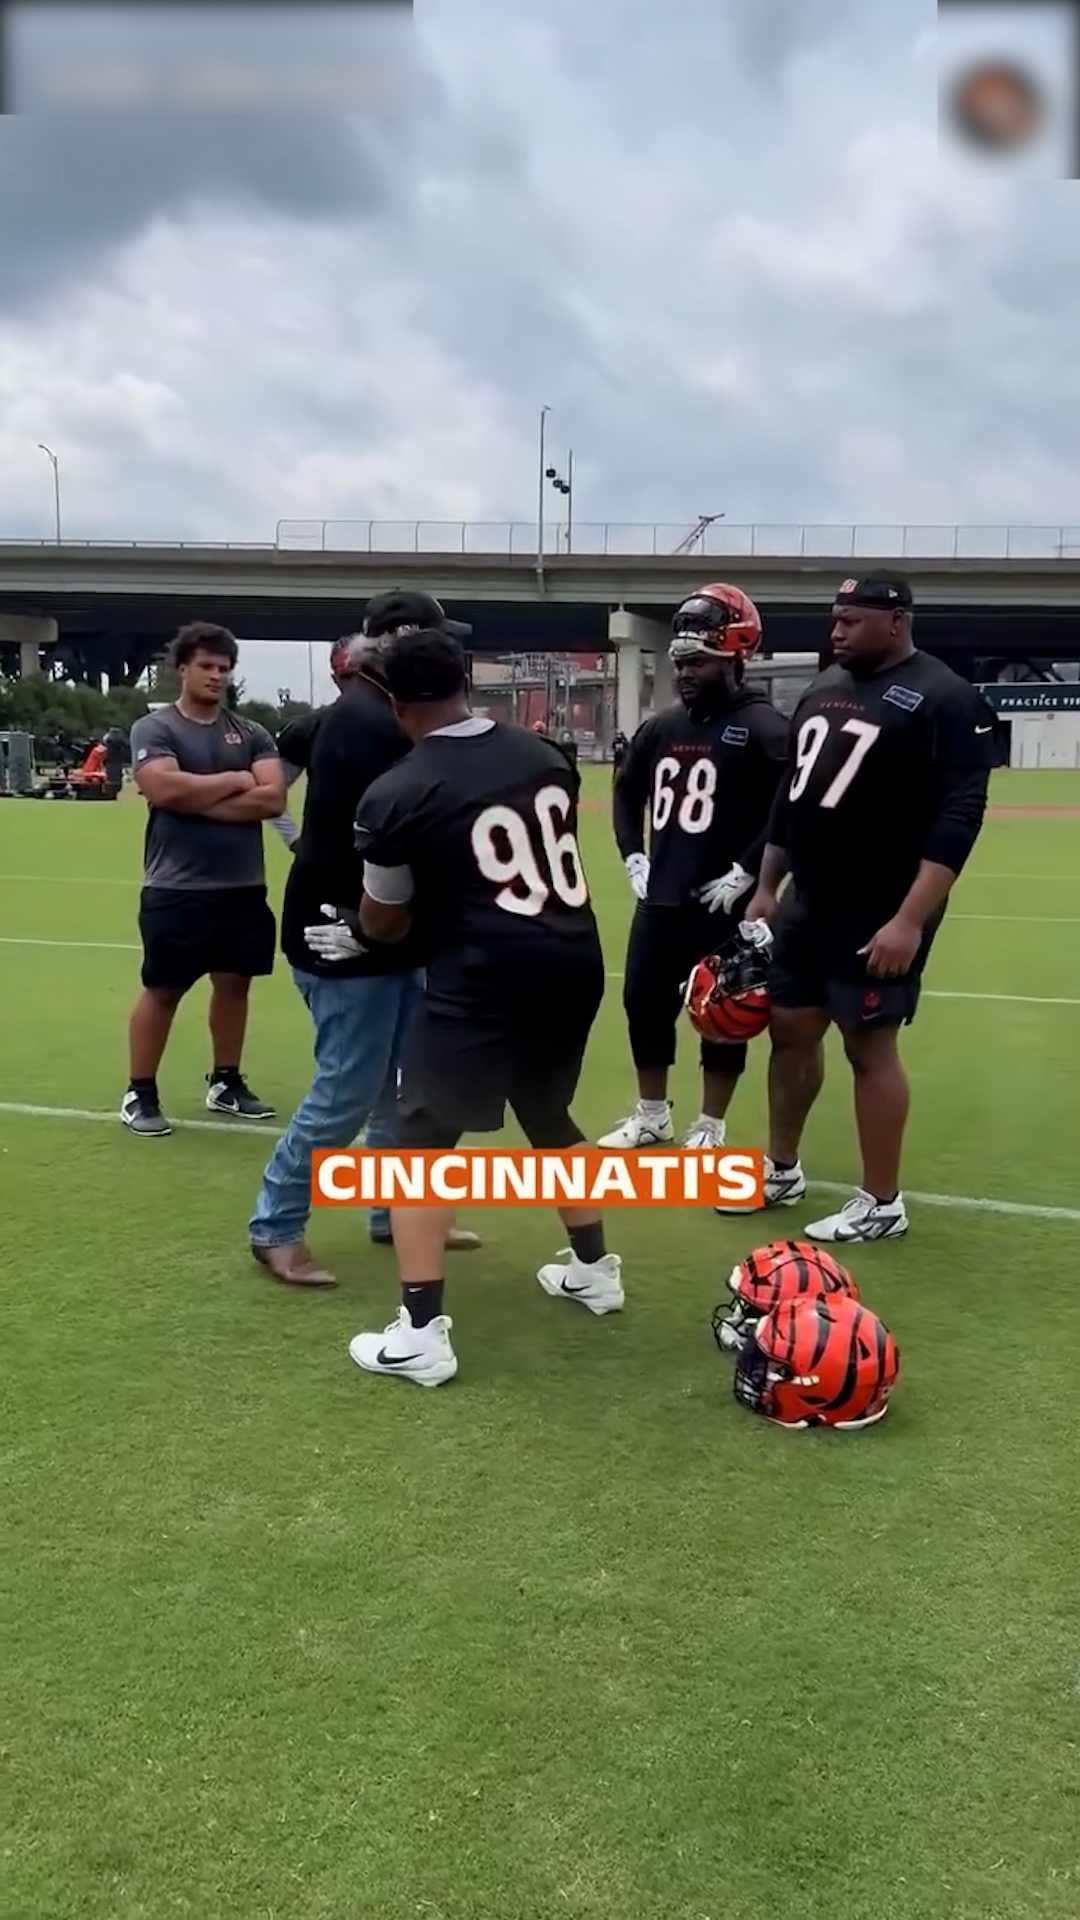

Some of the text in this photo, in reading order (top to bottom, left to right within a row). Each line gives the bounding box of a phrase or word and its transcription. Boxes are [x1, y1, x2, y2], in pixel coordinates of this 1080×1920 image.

[652, 757, 717, 834] 68
[789, 715, 881, 808] 97
[471, 785, 588, 917] 96
